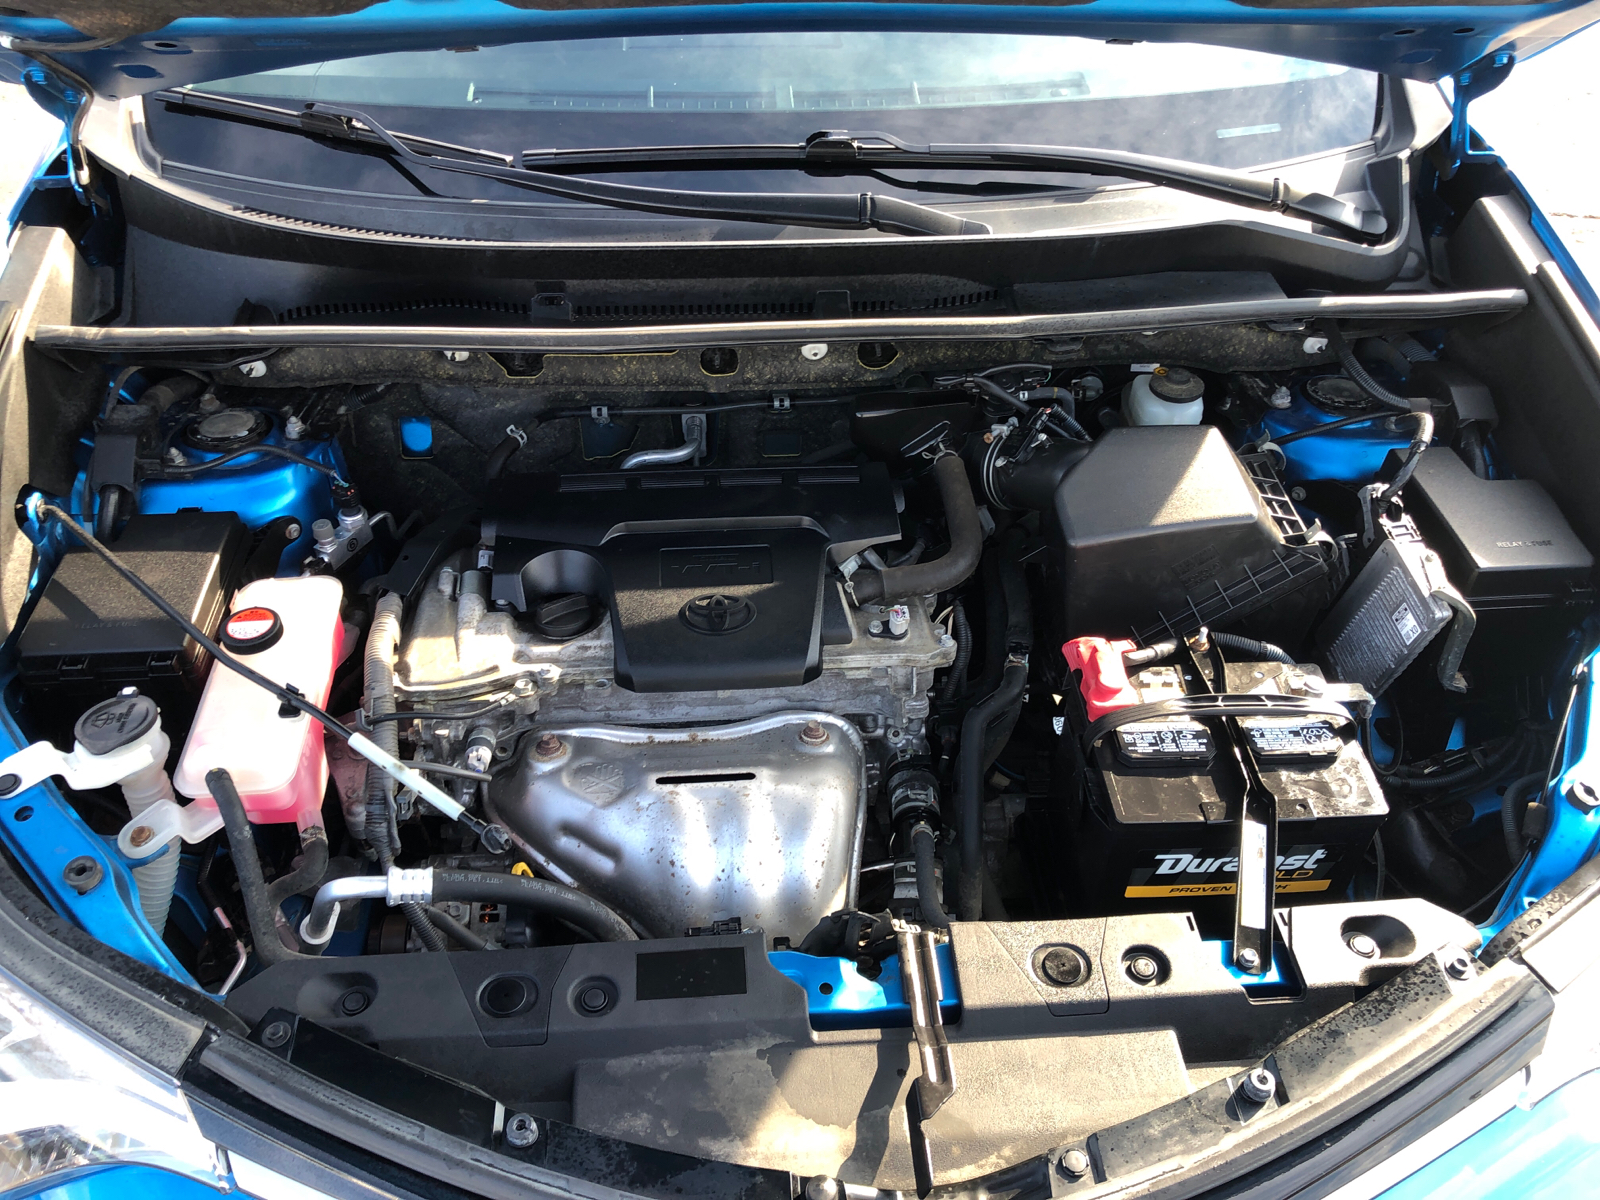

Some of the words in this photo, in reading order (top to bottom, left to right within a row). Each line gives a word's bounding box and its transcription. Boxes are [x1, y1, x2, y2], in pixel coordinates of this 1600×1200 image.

[1496, 541, 1523, 549] RELAY
[1154, 849, 1328, 875] Durast
[1168, 885, 1233, 894] PROVEN
